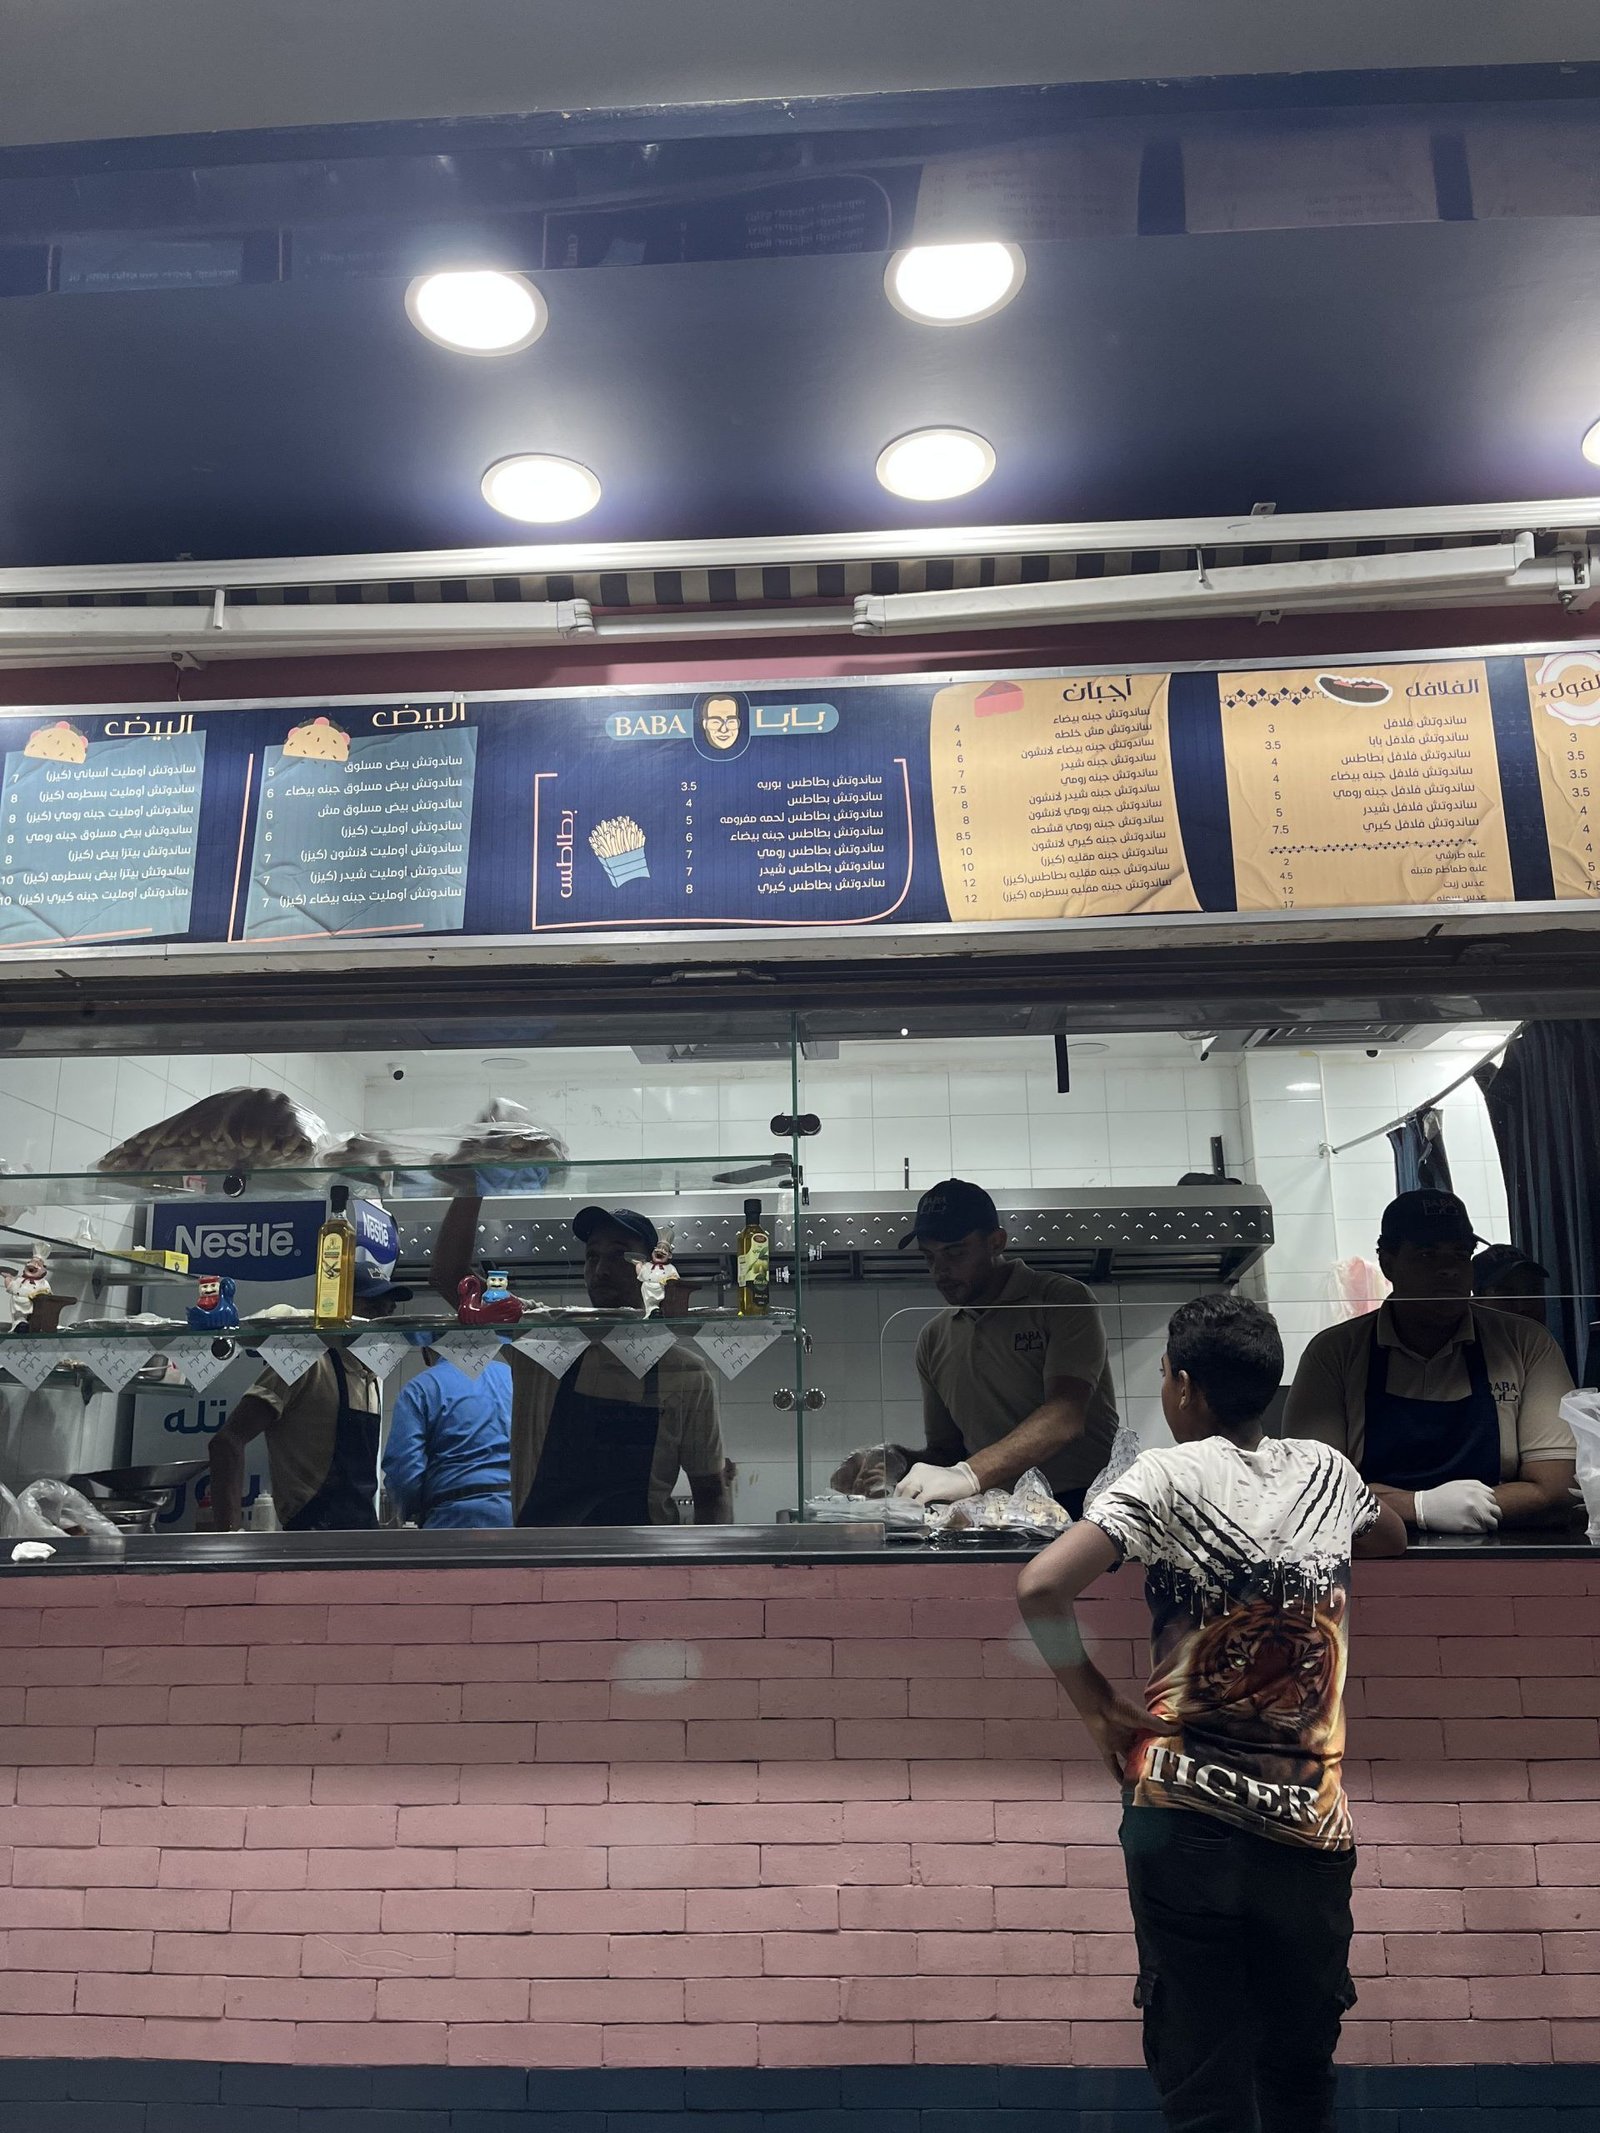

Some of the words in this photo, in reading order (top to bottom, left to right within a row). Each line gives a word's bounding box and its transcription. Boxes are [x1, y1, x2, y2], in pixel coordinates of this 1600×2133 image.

[1405, 679, 1479, 698] الفلافل
[1550, 674, 1600, 698] لفول
[372, 702, 465, 729] البيض
[756, 707, 826, 733] بابا
[614, 714, 687, 736] BABA
[1416, 716, 1467, 728] ساندوتش
[105, 715, 194, 740] البيض
[1268, 724, 1274, 733] 3
[1418, 732, 1469, 745] ساندوتش
[1570, 733, 1577, 742] 3
[1265, 741, 1281, 750] 3.5
[1420, 749, 1471, 762] ساندوتش
[1568, 751, 1584, 760] 3.5
[412, 756, 463, 769] ساندوتش
[1272, 758, 1278, 766] 4
[148, 764, 196, 777] ساندوتش
[268, 767, 274, 776] 5
[958, 770, 964, 778] 7
[1569, 769, 1587, 779] 3.5
[11, 774, 19, 782] 7
[832, 775, 882, 787] ساندوتش
[412, 777, 463, 790] ساندوتش
[681, 782, 696, 791] 3.5
[267, 789, 274, 798] 6
[952, 785, 966, 794] 7.5
[1424, 783, 1475, 795] ساندوتش
[1572, 787, 1590, 797] 3.5
[833, 791, 883, 804] ساندوتش
[1275, 791, 1281, 800] 5
[686, 799, 692, 807] 4
[833, 809, 883, 821] ساندوتش
[1580, 806, 1587, 815] 4
[686, 816, 692, 824] 5
[963, 816, 969, 824] 8
[1428, 817, 1479, 829] ساندوتش
[144, 825, 193, 838] ساندوتش
[411, 821, 462, 834] ساندوتش
[834, 826, 883, 838] ساندوتش
[1273, 825, 1289, 834] 7.5
[1583, 825, 1589, 833] 4
[7, 835, 14, 843] 8
[265, 832, 272, 841] 6
[686, 833, 692, 842] 6
[142, 845, 191, 858] ساندوتش
[834, 843, 884, 856] ساندوتش
[961, 847, 972, 855] 10
[1586, 843, 1592, 852] 4
[556, 809, 578, 899] بطاطس
[686, 850, 692, 859] 7
[5, 855, 12, 864] 8
[142, 866, 190, 878] ساندوتش
[962, 863, 974, 871] 10
[1588, 862, 1595, 872] 5
[1, 876, 13, 884] 10
[835, 878, 885, 891] ساندوتش
[410, 887, 462, 900] ساندوتش
[686, 884, 693, 893] 8
[263, 898, 269, 907] 7
[362, 1211, 389, 1247] Nestlé
[175, 1222, 293, 1259] Nestlé
[1145, 1745, 1321, 1824] TIGER
